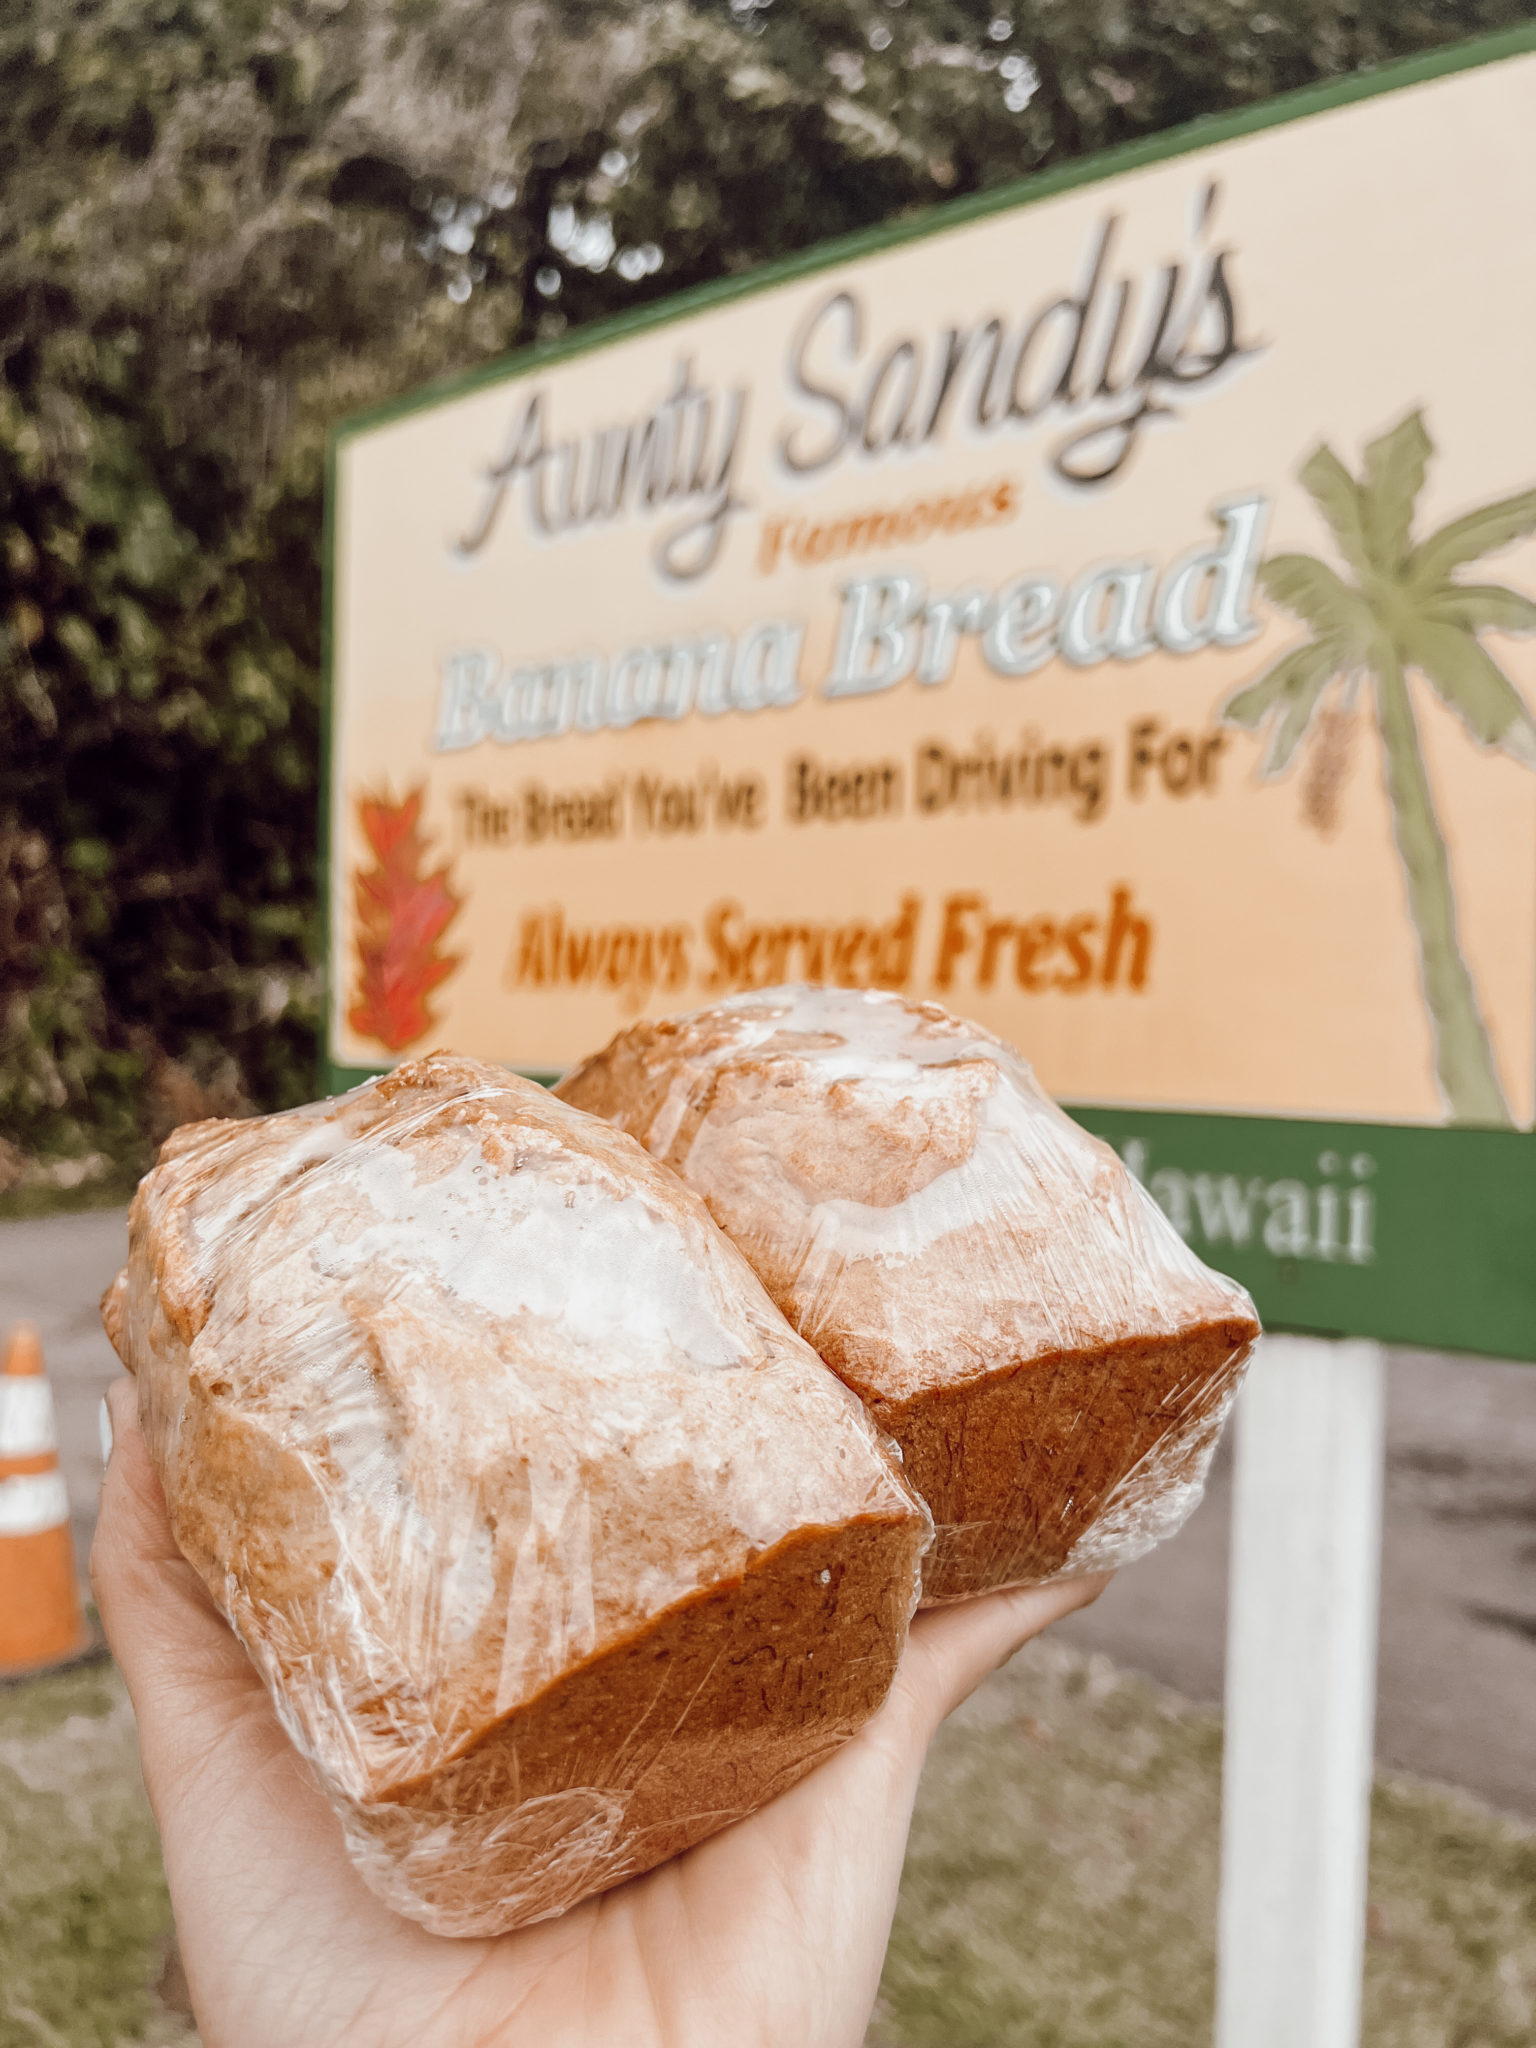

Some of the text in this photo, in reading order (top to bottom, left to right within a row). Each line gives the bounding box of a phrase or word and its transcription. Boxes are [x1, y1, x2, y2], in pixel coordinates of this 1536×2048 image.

[454, 178, 1270, 582] Aunty Sandy's
[434, 496, 1268, 752] Banana Bread
[455, 714, 1230, 846] The Bread You've Been Driving For
[512, 884, 1158, 1012] Always Served Fresh
